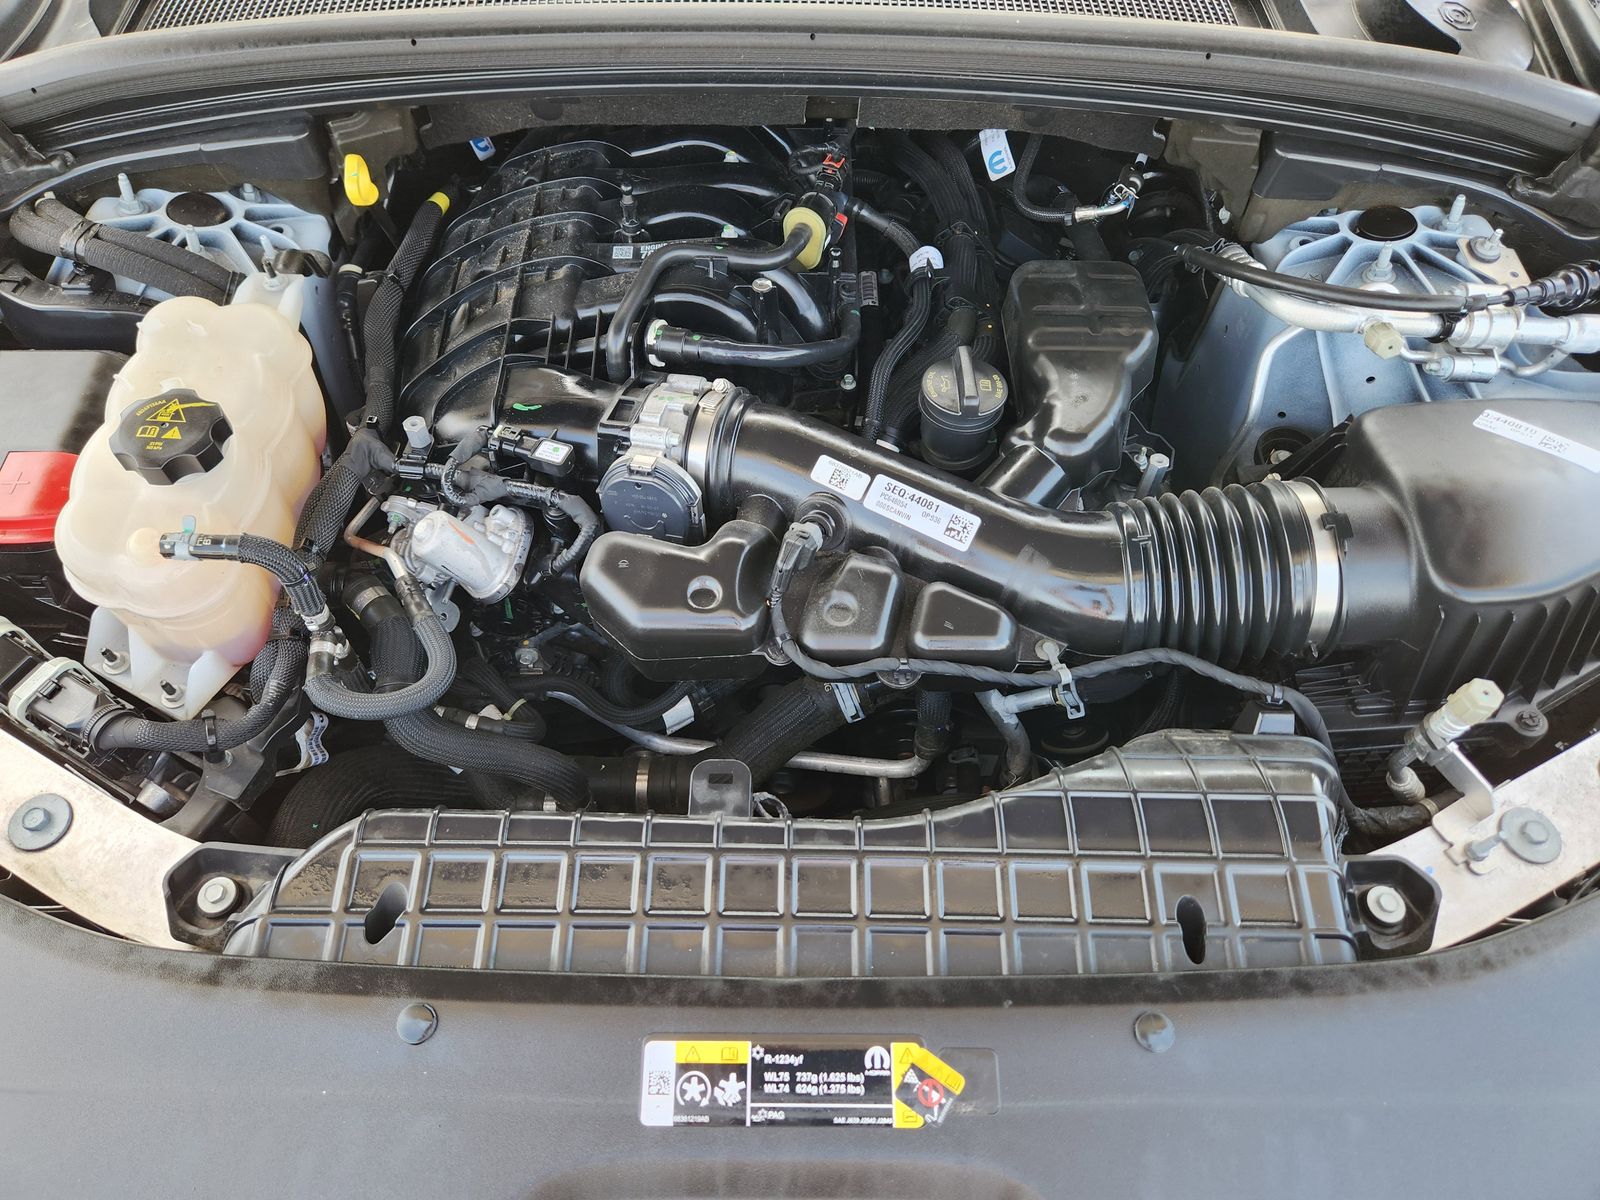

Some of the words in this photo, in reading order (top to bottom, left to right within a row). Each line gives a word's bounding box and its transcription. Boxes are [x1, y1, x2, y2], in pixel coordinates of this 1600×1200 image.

[884, 482, 940, 513] SEQ:44081
[764, 1053, 804, 1067] R-1234yf
[795, 1072, 818, 1084] 737g
[847, 1072, 865, 1084] lbs)
[763, 1083, 790, 1094] WL74
[795, 1083, 818, 1096] 624g
[819, 1083, 846, 1096] (1.375
[847, 1083, 865, 1096] lbs)
[767, 1110, 785, 1120] PAG
